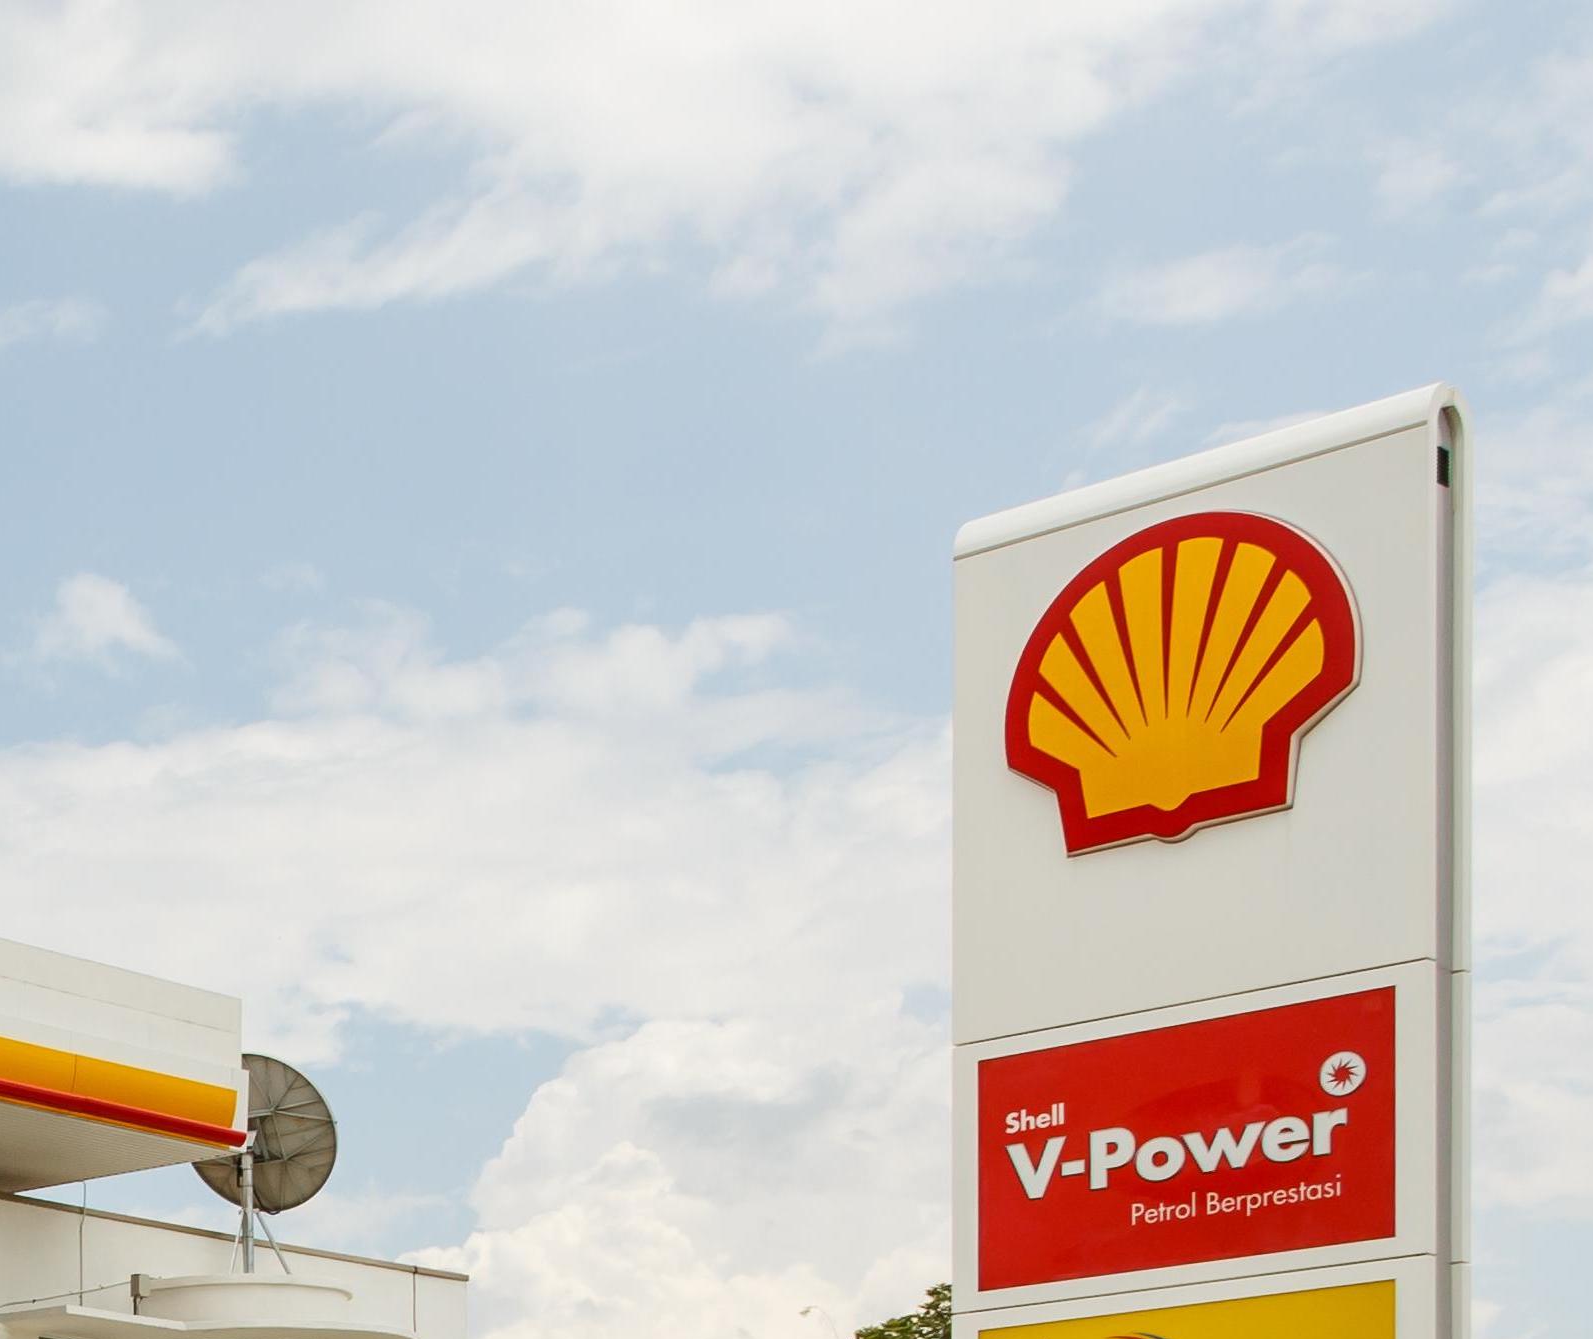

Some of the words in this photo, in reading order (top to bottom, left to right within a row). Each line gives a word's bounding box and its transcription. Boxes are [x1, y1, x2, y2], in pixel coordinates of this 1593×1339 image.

[1005, 1102, 1065, 1134] Shell
[1006, 1107, 1349, 1200] V-Power
[1131, 1192, 1197, 1226] Petrol
[1206, 1174, 1342, 1217] Berprestasi
